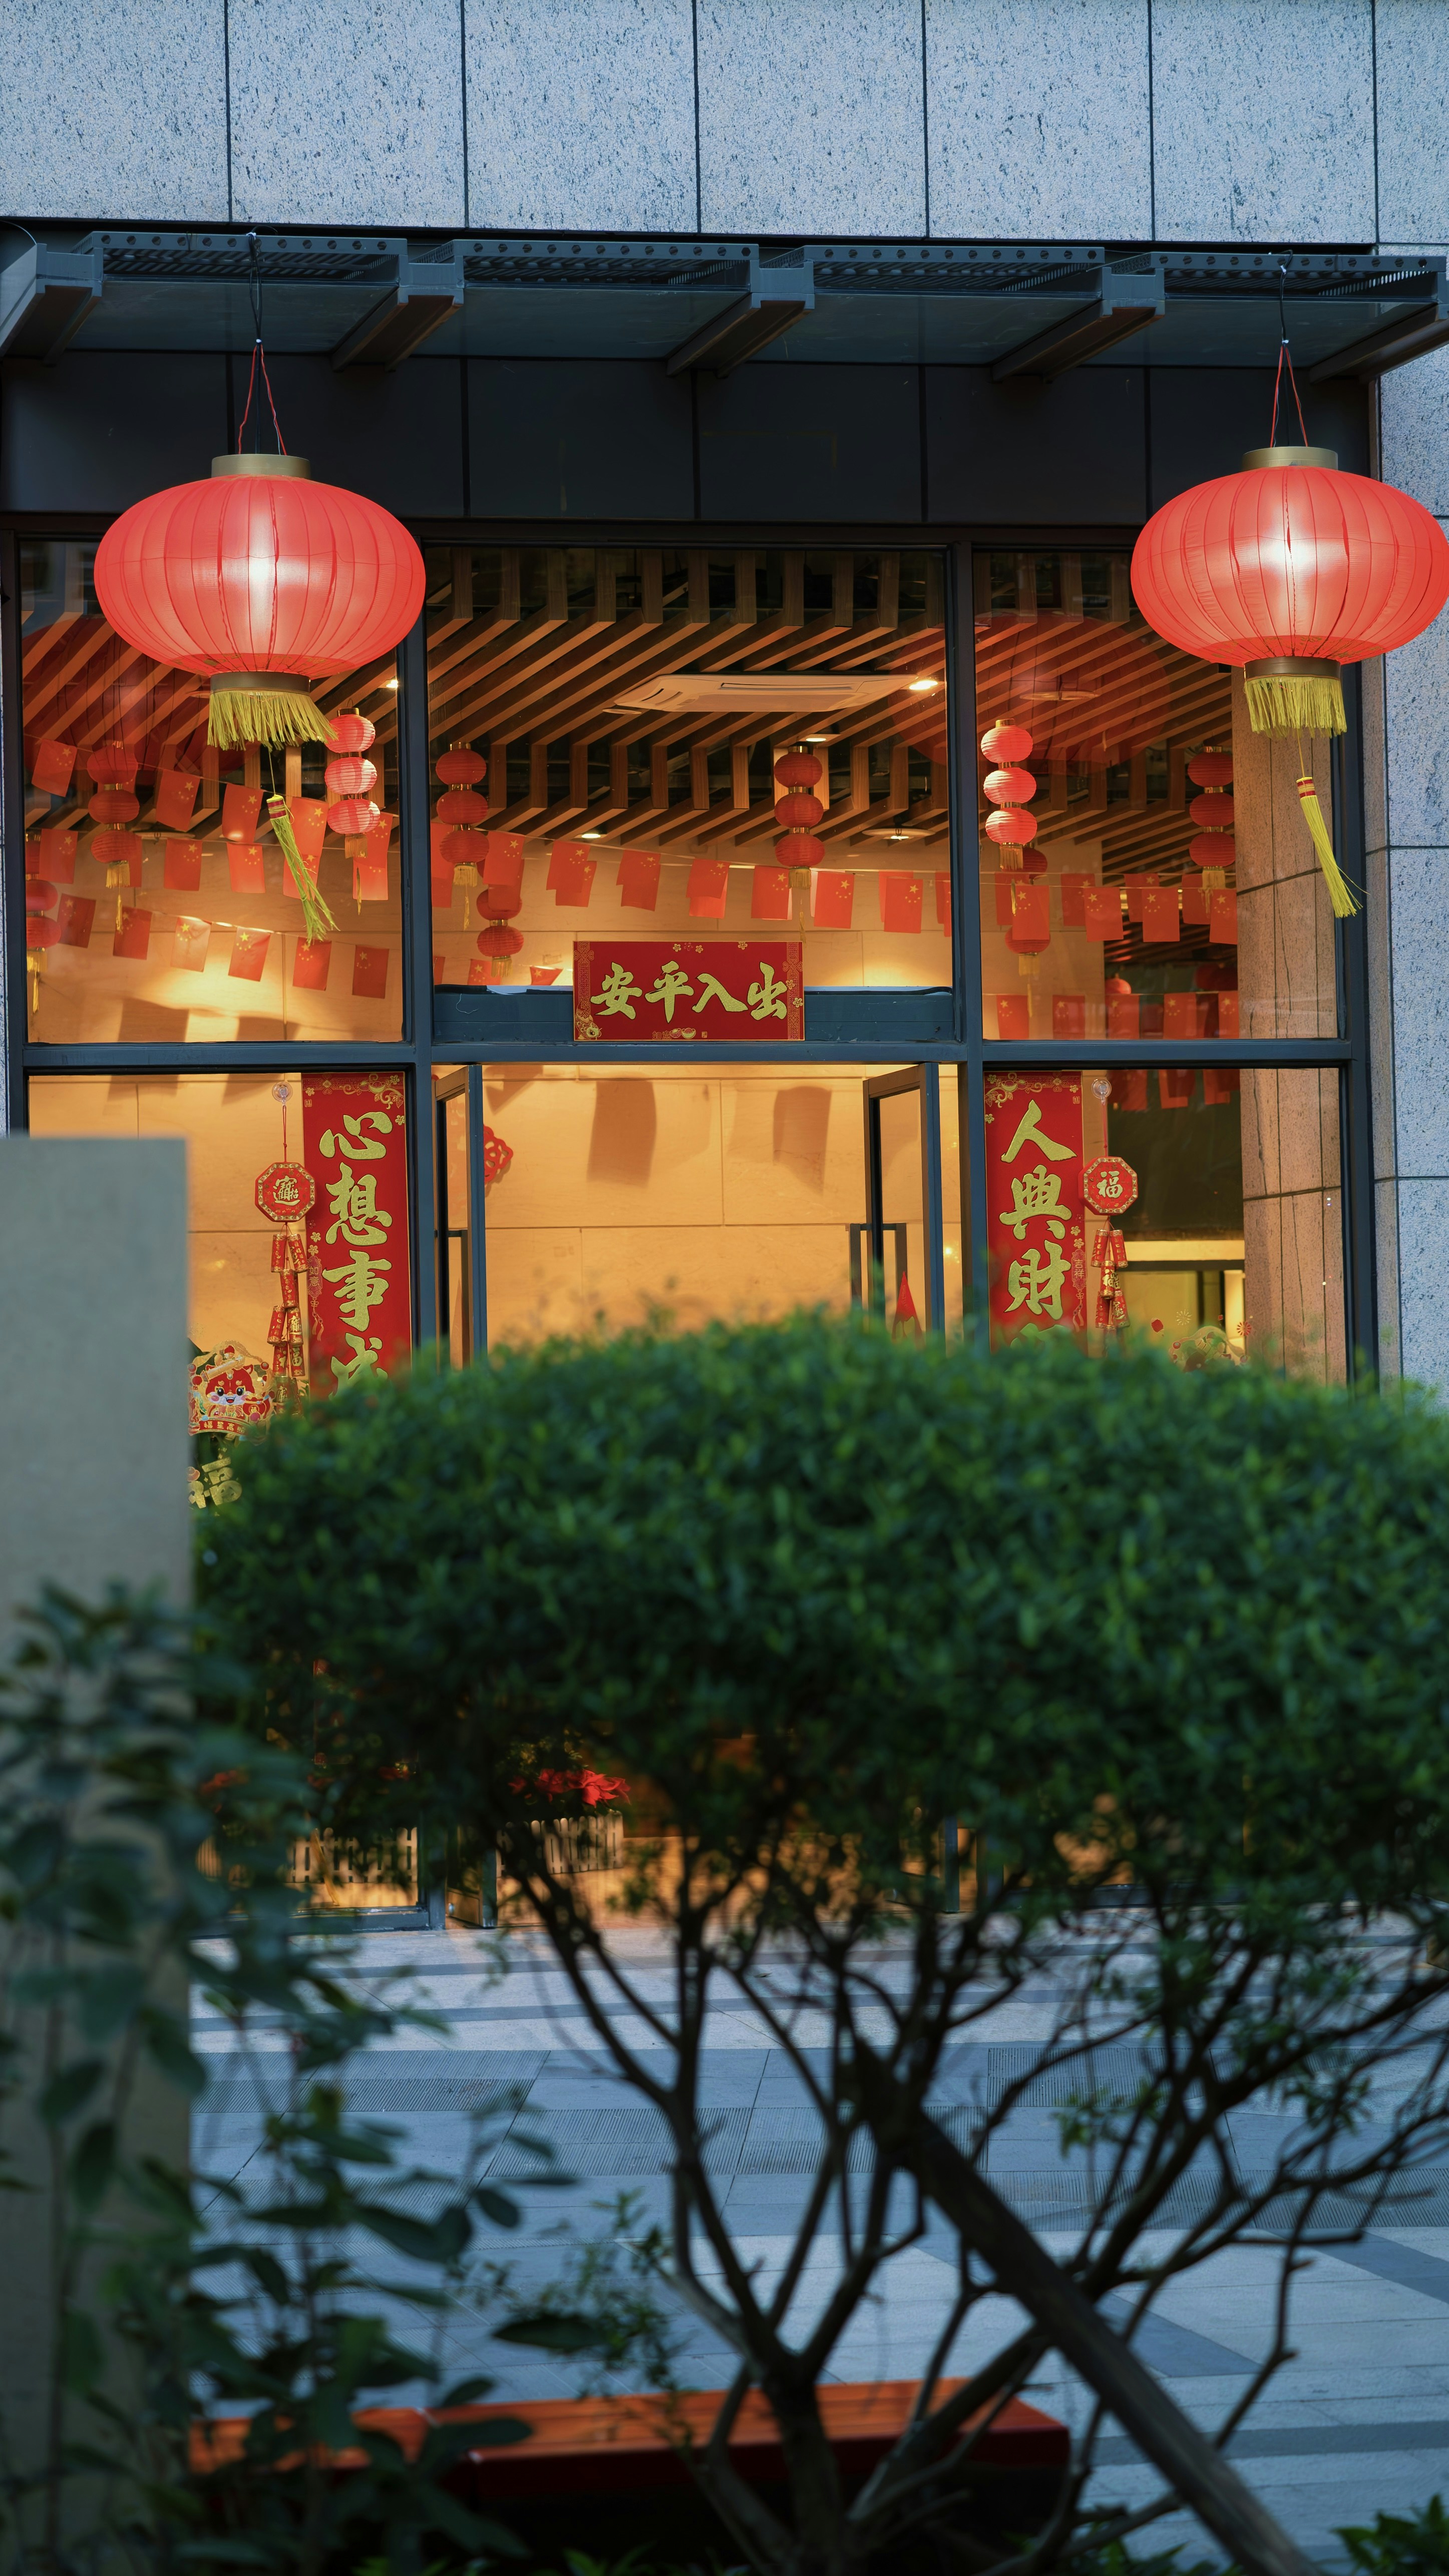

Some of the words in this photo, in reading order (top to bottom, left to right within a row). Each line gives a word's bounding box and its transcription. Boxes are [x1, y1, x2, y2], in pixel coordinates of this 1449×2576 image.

[652, 1031, 671, 1040] 如意
[1097, 1171, 1123, 1198] 福
[309, 1267, 319, 1286] 如意
[1074, 1259, 1084, 1278] 吉祥
